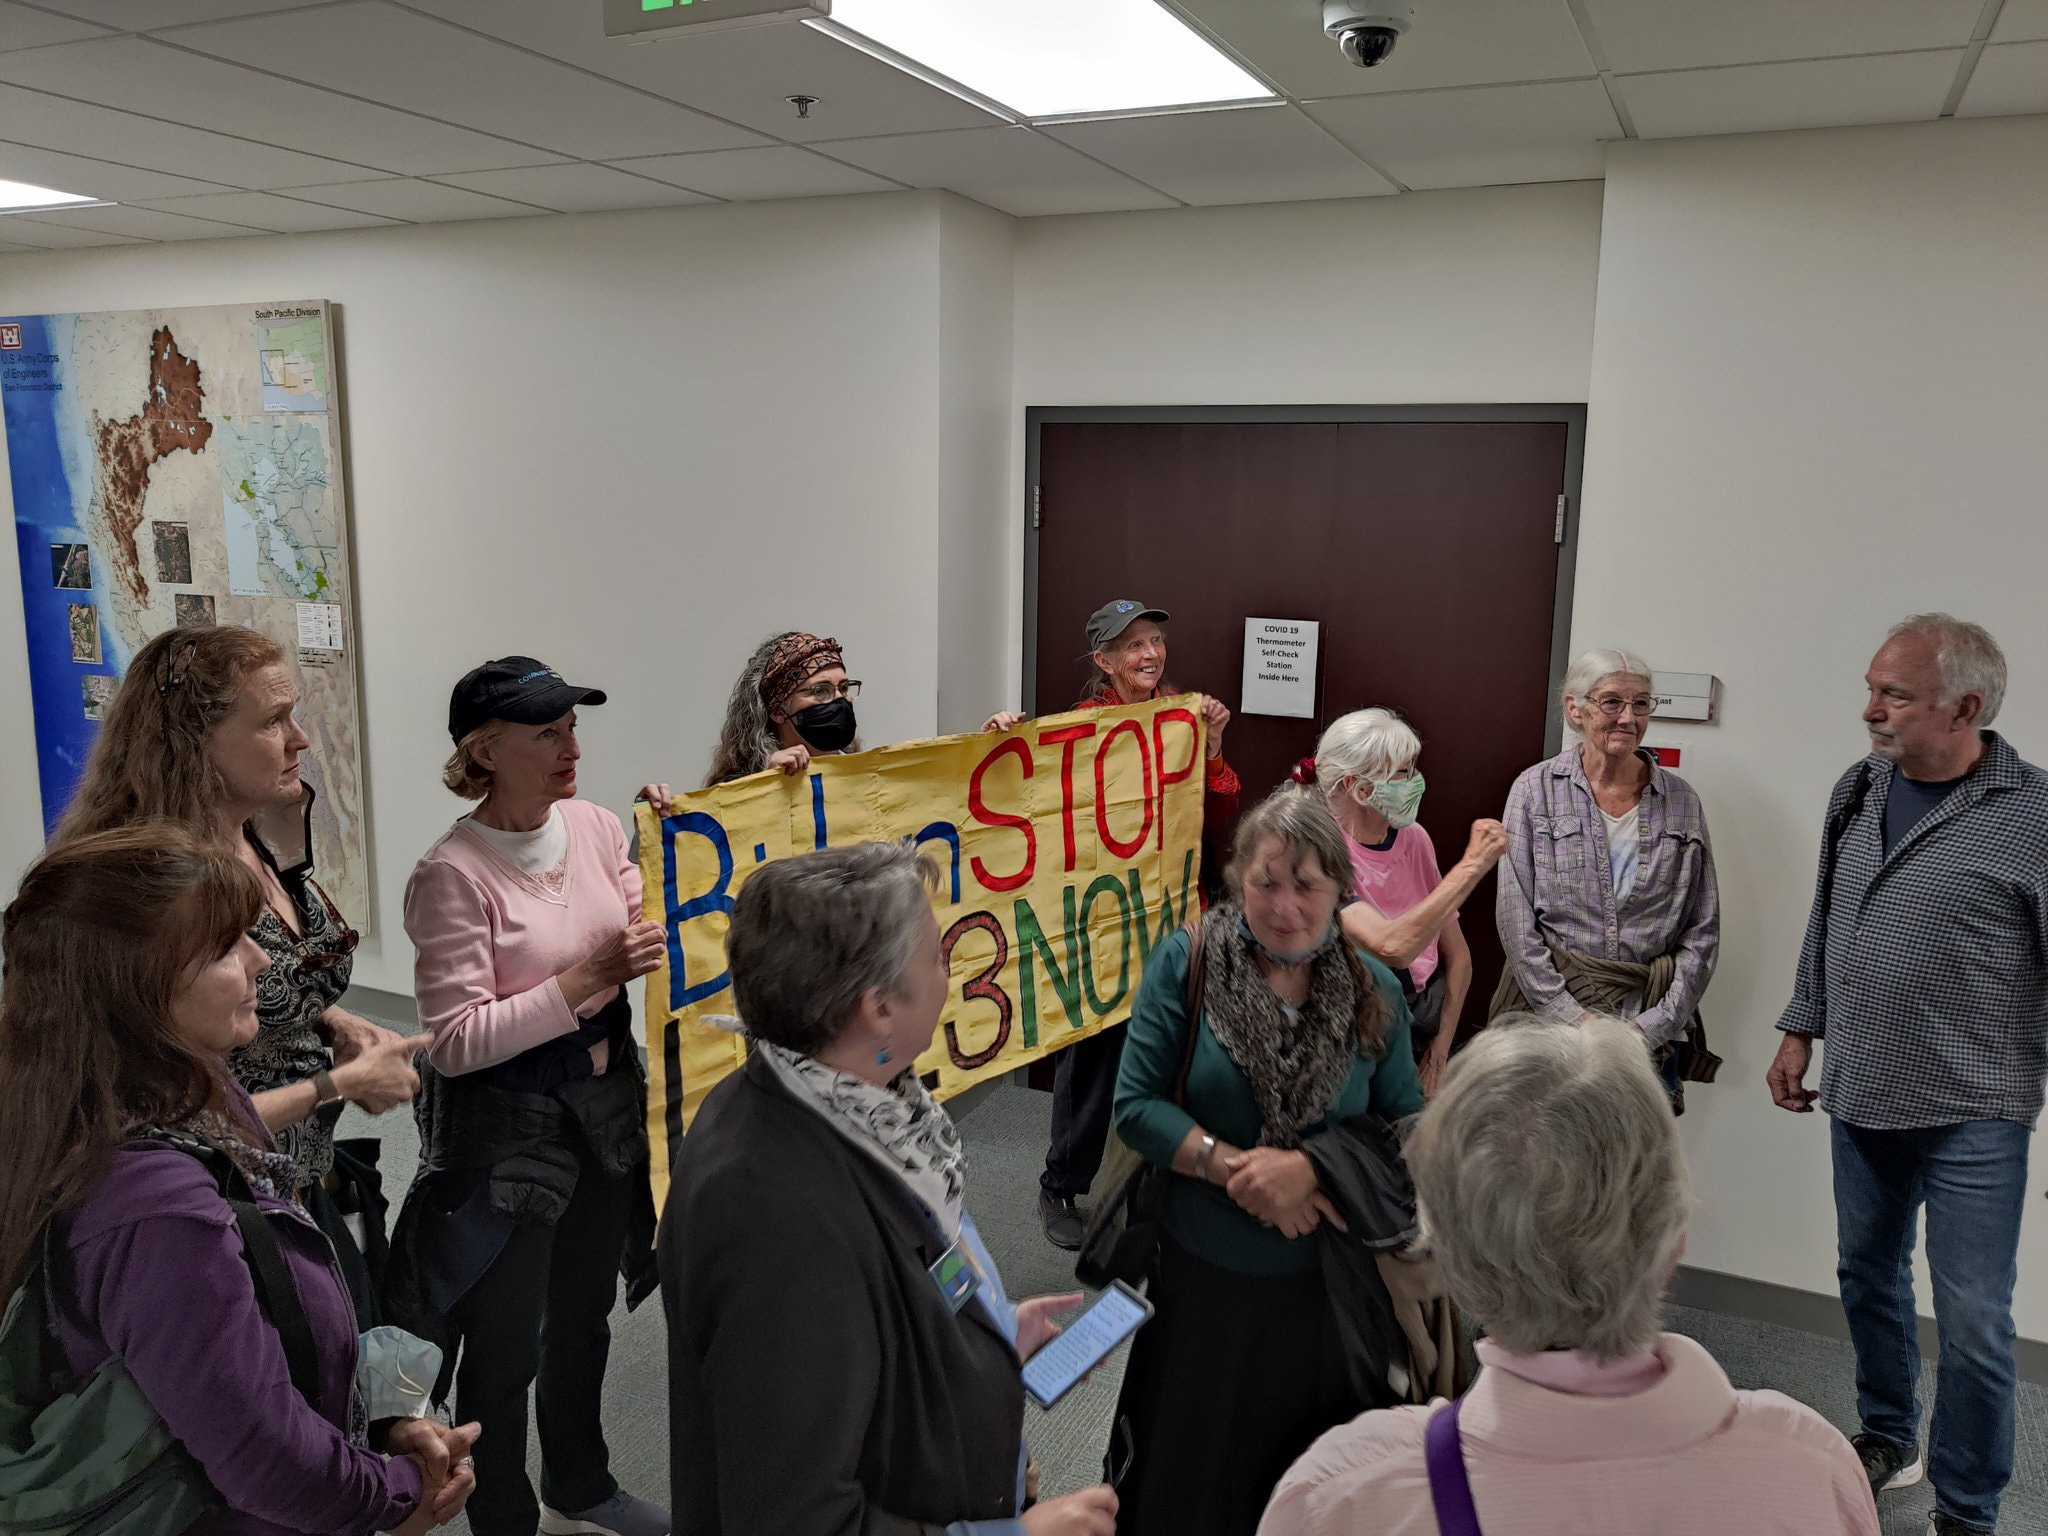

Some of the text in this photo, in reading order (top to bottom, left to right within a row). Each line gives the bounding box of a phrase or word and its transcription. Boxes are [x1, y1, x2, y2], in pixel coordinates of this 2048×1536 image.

[255, 308, 321, 319] South Pacific Division
[18, 353, 36, 366] Army
[37, 353, 60, 366] Corps
[3, 367, 48, 381] of Engineers
[1264, 625, 1299, 635] COVID 19
[1256, 637, 1306, 648] Thermometer
[1261, 649, 1299, 659] Self-Check
[1266, 661, 1292, 670] Station
[1258, 673, 1299, 683] Inside Here
[968, 708, 1198, 892] STOP
